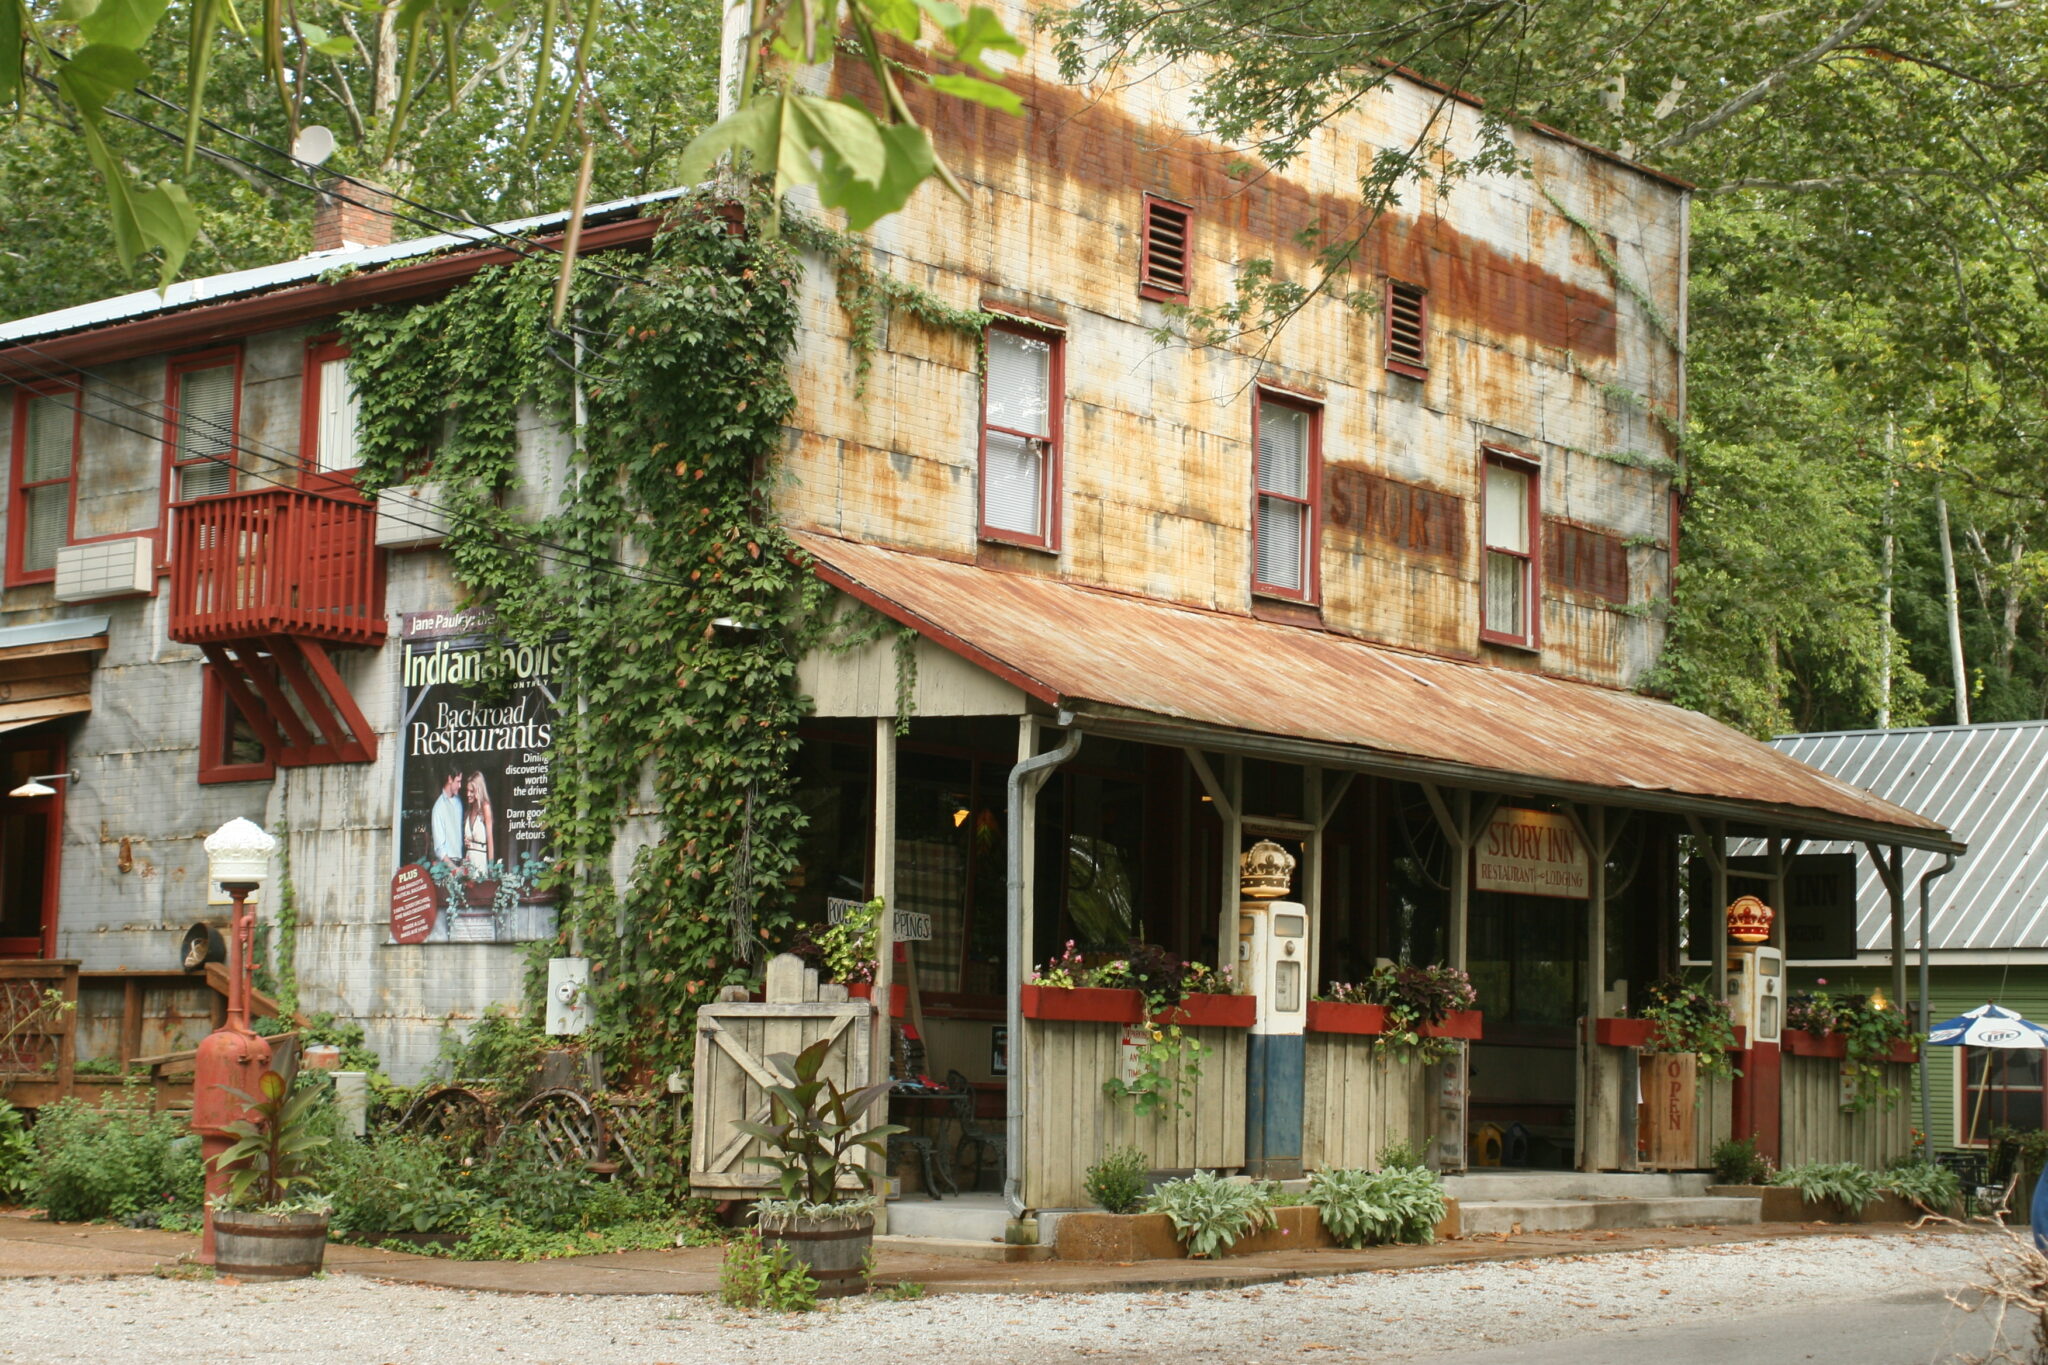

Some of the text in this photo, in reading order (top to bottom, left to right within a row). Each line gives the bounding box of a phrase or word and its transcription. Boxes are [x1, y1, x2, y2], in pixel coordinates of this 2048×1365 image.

[411, 616, 434, 635] Jane
[509, 679, 549, 689] ONTHLY
[436, 696, 527, 730] Backroad
[411, 717, 551, 756] Restaurants
[523, 753, 549, 765] Dining
[505, 764, 549, 775] discoveries
[525, 774, 548, 785] worth
[513, 785, 548, 796] the drive
[506, 807, 547, 820] Darn good
[508, 819, 546, 832] junk-foo
[515, 830, 546, 841] detours
[1488, 821, 1576, 865] STORY INN
[398, 868, 419, 884] PLUS
[1481, 863, 1583, 888] RESTAURANT LODGING
[894, 911, 931, 939] PPINGS
[1130, 1052, 1139, 1062] AN
[1128, 1068, 1139, 1078] TIM
[1667, 1060, 1682, 1131] OPEN
